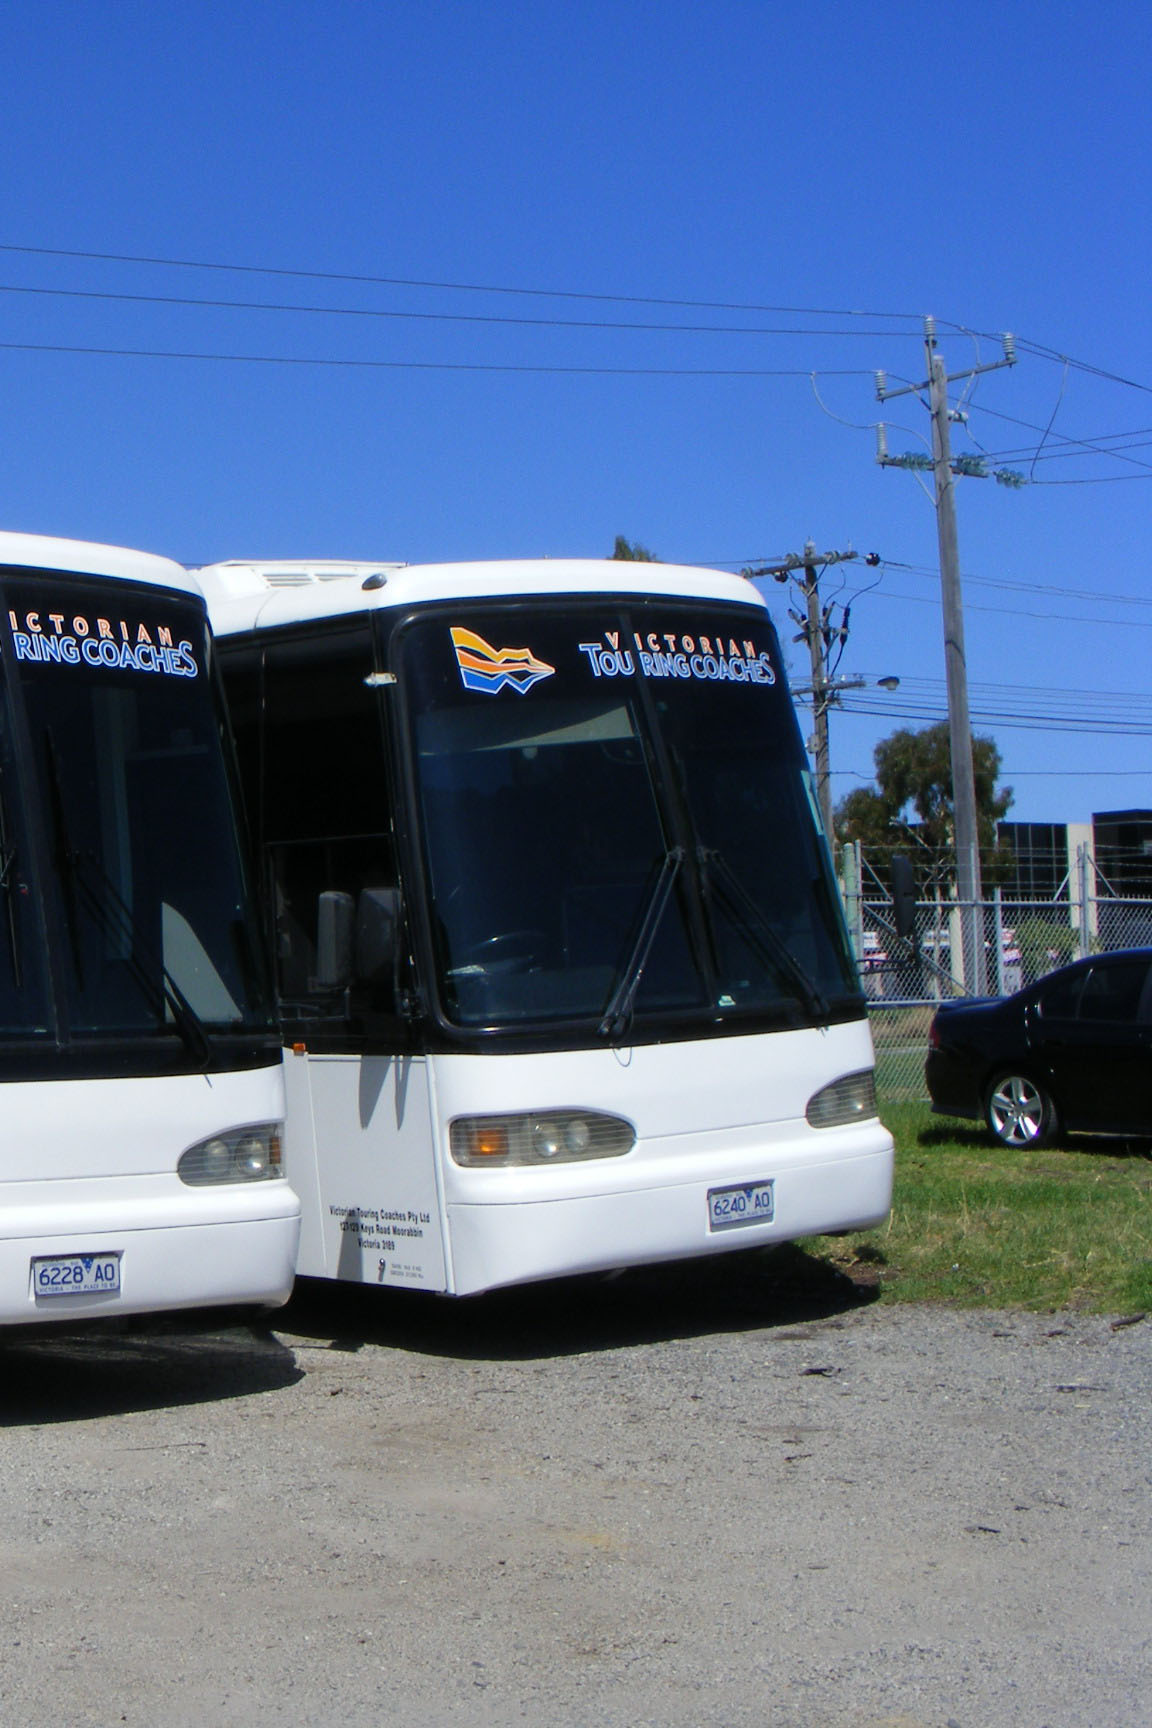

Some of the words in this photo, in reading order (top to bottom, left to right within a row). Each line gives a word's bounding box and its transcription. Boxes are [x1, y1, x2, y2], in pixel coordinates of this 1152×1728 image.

[605, 632, 755, 657] VICTORIAN
[329, 1205, 357, 1217] Victorian
[357, 1207, 379, 1222] Touring
[380, 1208, 406, 1222] Coaches
[408, 1211, 418, 1224] Pty
[419, 1211, 430, 1223] Ltd
[714, 1196, 746, 1216] 6240
[376, 1224, 391, 1236] Road
[391, 1226, 423, 1238] Moorabbin
[358, 1238, 381, 1250] Victoria
[39, 1266, 84, 1286] 6228
